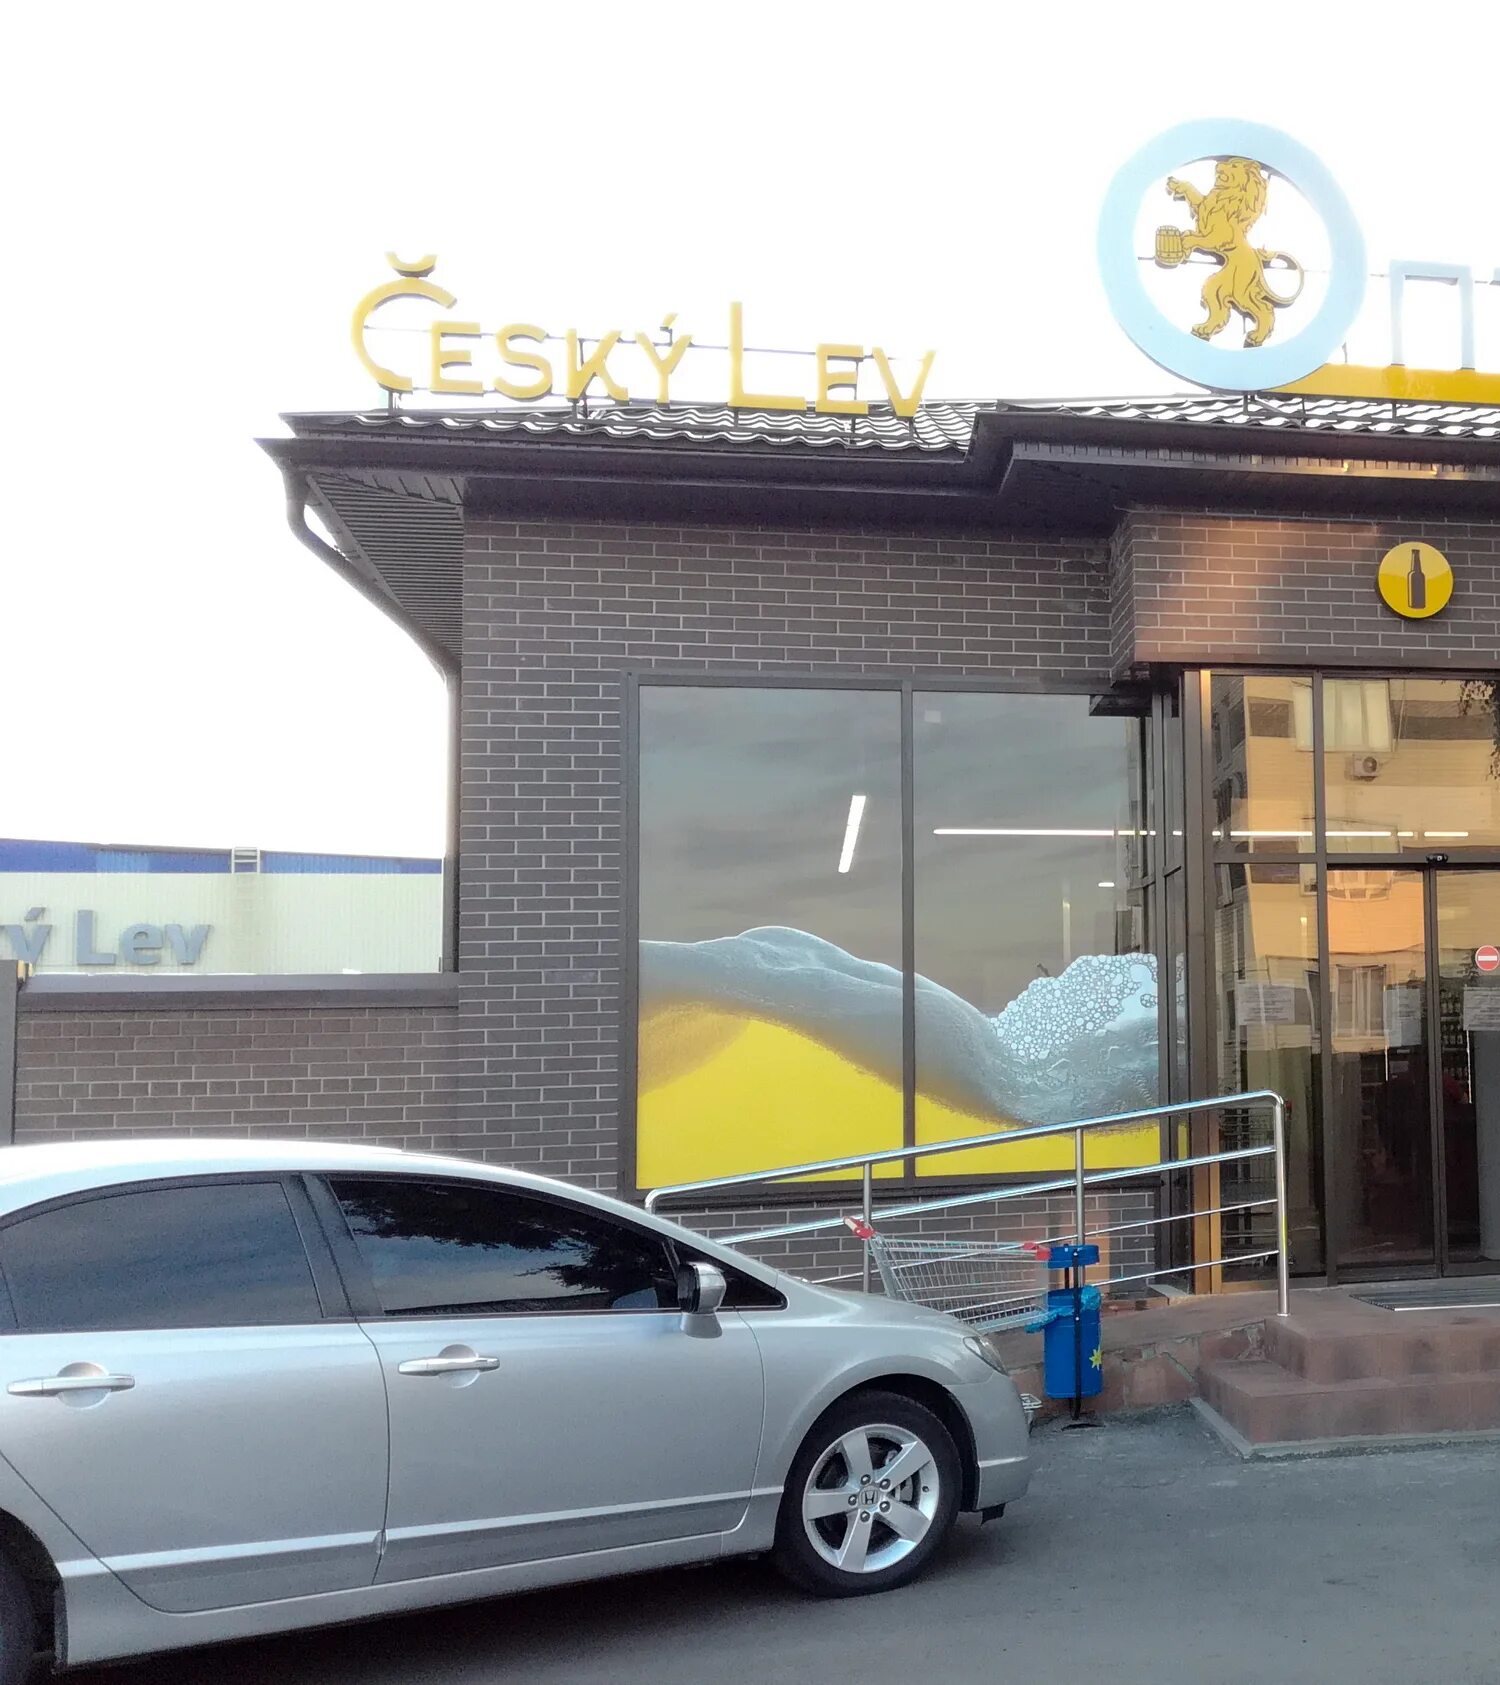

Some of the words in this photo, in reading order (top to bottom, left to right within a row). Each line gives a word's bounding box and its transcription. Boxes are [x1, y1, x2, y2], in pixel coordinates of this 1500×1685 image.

[352, 251, 693, 404] ČESKÝ
[728, 301, 936, 416] LEV
[76, 909, 213, 965] Lev
